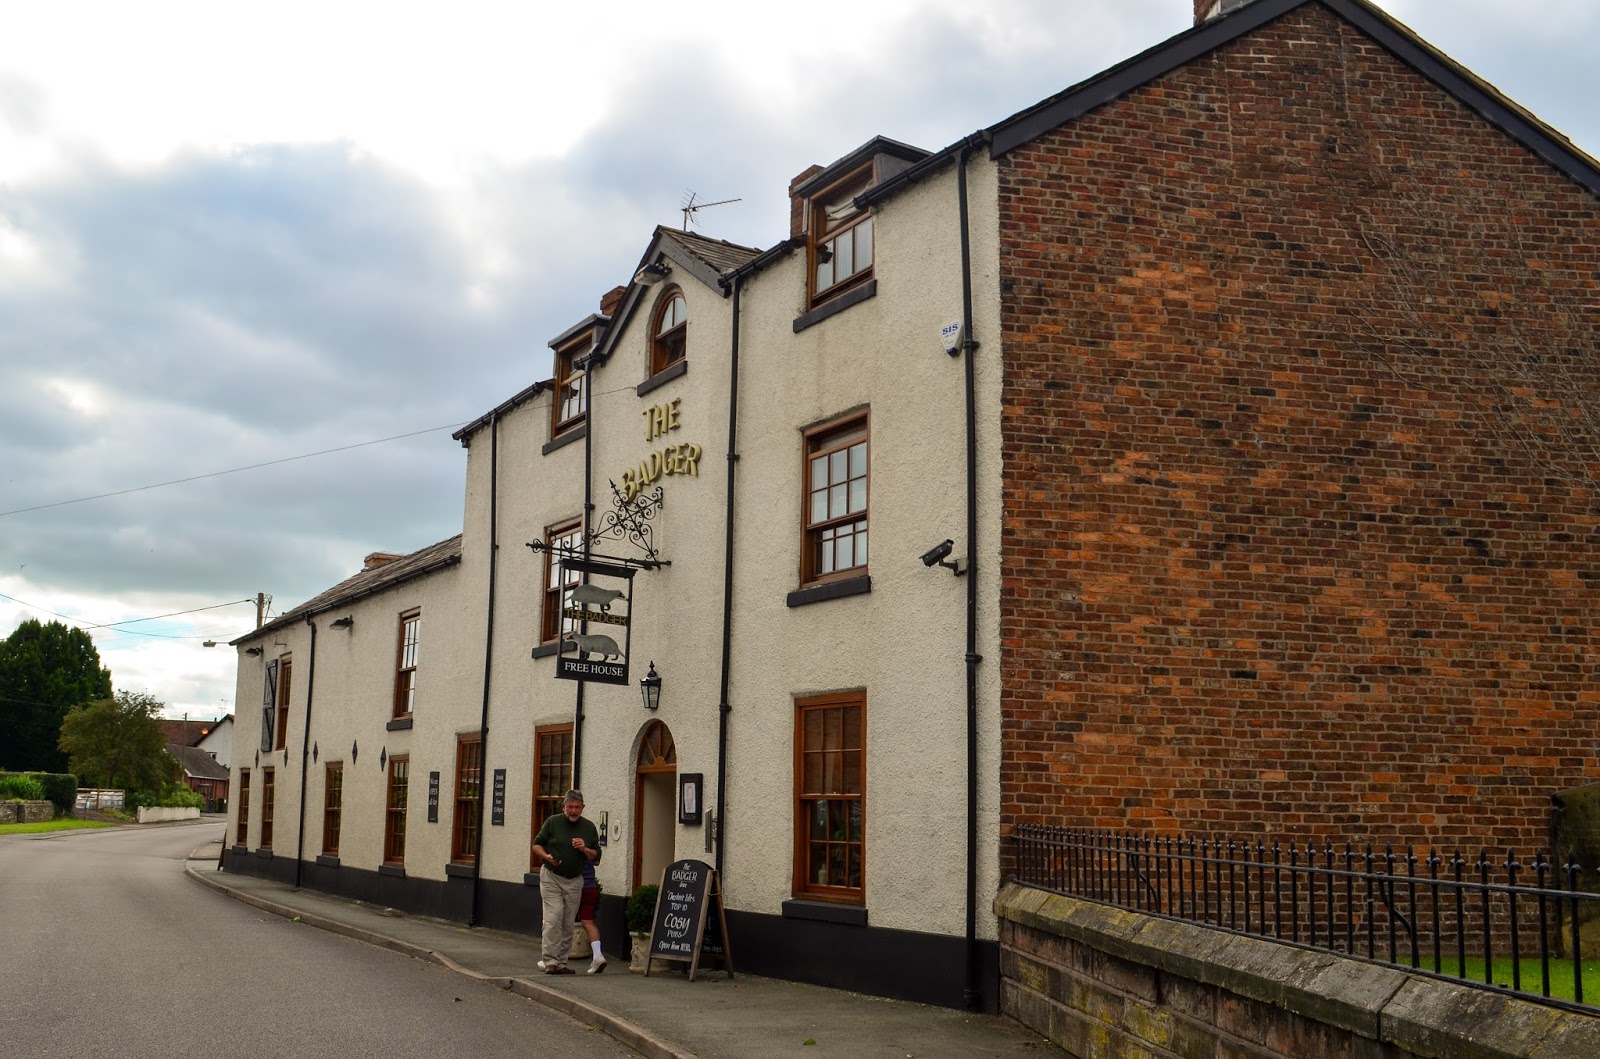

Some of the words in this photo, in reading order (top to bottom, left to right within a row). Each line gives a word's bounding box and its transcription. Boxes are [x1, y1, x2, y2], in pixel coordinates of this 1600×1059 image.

[942, 323, 958, 335] SIS
[642, 396, 683, 442] THE
[621, 442, 702, 504] BADGER
[565, 608, 585, 620] THE
[586, 611, 627, 625] BADGER
[564, 661, 589, 673] FREE
[591, 665, 624, 677] HOUSE
[671, 870, 698, 881] BADGER
